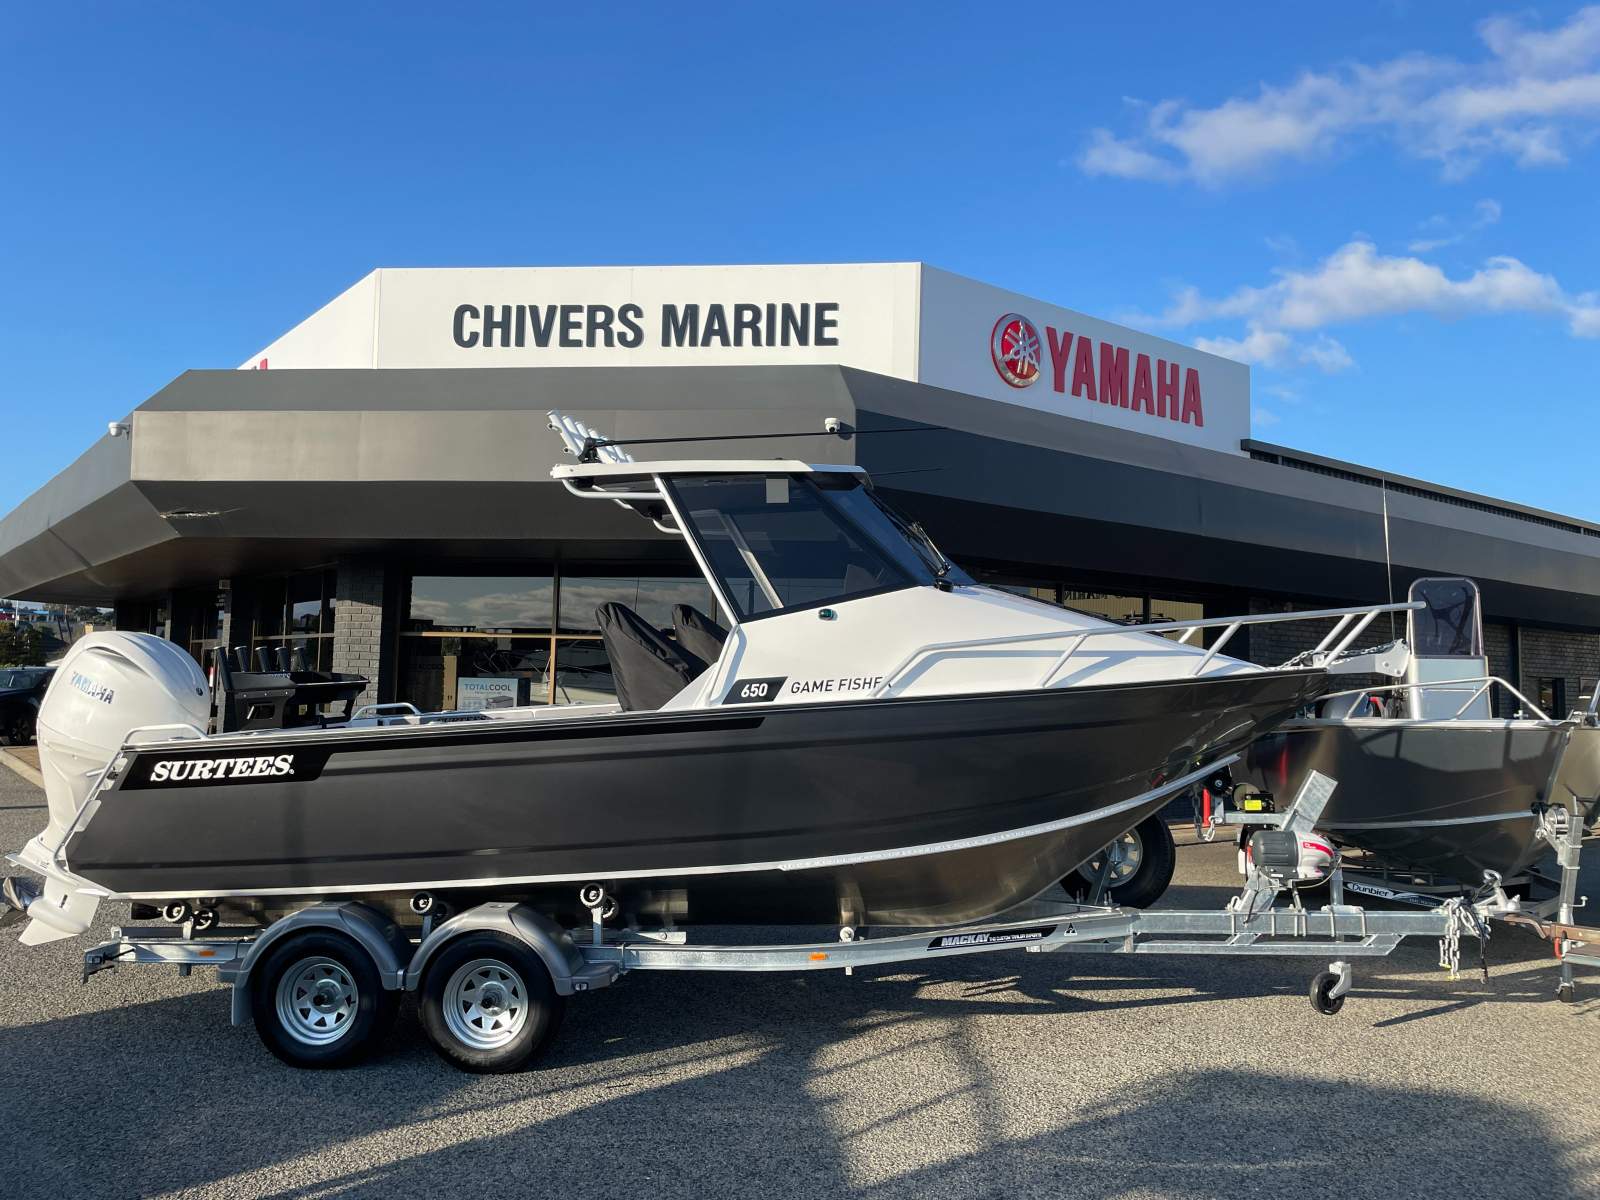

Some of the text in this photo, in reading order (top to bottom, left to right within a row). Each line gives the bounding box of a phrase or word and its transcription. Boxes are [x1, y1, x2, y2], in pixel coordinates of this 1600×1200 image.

[453, 302, 840, 349] CHIVERS MARINE
[1046, 326, 1204, 428] YAMAHA
[464, 682, 512, 692] TOTALCOOL
[740, 682, 769, 699] 650
[790, 679, 834, 694] GAME
[150, 754, 294, 782] SURTEES
[1352, 883, 1389, 898] Dunbier
[941, 933, 991, 947] MACKAY
